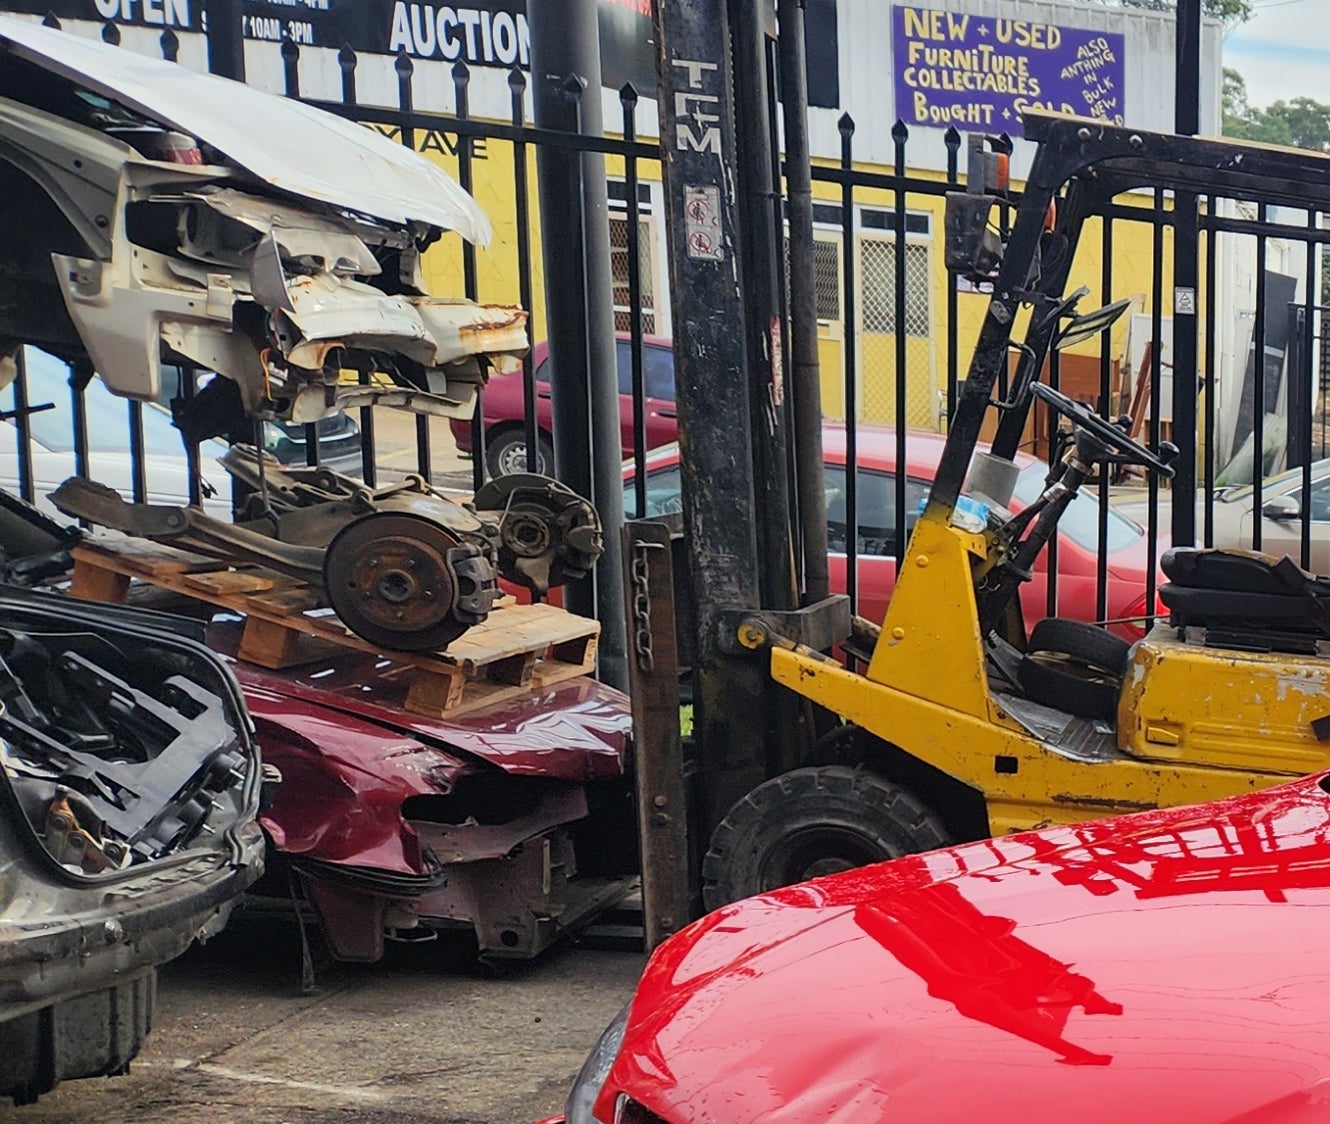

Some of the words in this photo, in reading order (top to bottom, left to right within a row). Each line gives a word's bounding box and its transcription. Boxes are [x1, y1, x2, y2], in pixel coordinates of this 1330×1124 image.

[250, 16, 280, 40] 10AM
[288, 21, 313, 43] 3PM
[904, 7, 970, 41] NEW
[977, 24, 990, 37] +
[995, 18, 1061, 50] USED
[1077, 37, 1108, 58] ALSO
[1061, 49, 1116, 78] ANTHING
[1083, 71, 1097, 85] IN
[903, 67, 1041, 97] COLLECTABLES
[1082, 75, 1114, 104] BULK
[1090, 97, 1116, 117] NEW
[419, 130, 488, 160] AVE
